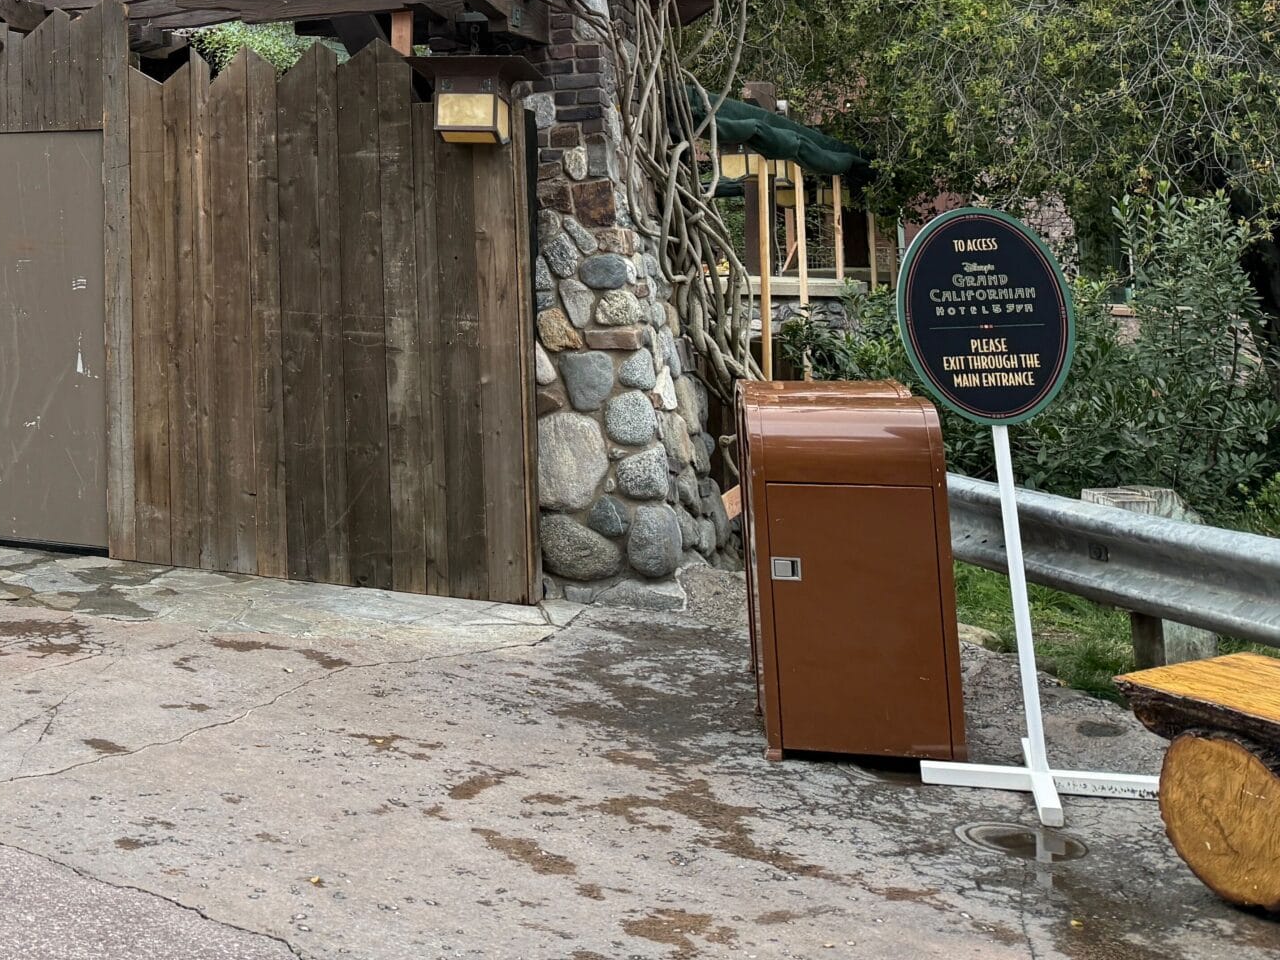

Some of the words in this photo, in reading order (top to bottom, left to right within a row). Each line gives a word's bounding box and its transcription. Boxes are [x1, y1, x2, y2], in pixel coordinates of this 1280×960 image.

[953, 240, 965, 252] TO
[967, 238, 998, 251] ACCESS
[952, 274, 1008, 287] GRAND
[929, 287, 1036, 303] CALIFORNIAN
[936, 305, 989, 316] HOTEL
[1005, 303, 1034, 314] SPA
[970, 338, 1008, 352] PLEASE
[943, 356, 965, 370] EXIT
[968, 354, 1018, 370] THROUGH
[1020, 353, 1041, 368] THE
[953, 373, 979, 387] MAIN
[982, 372, 1035, 387] ENTRANCE
